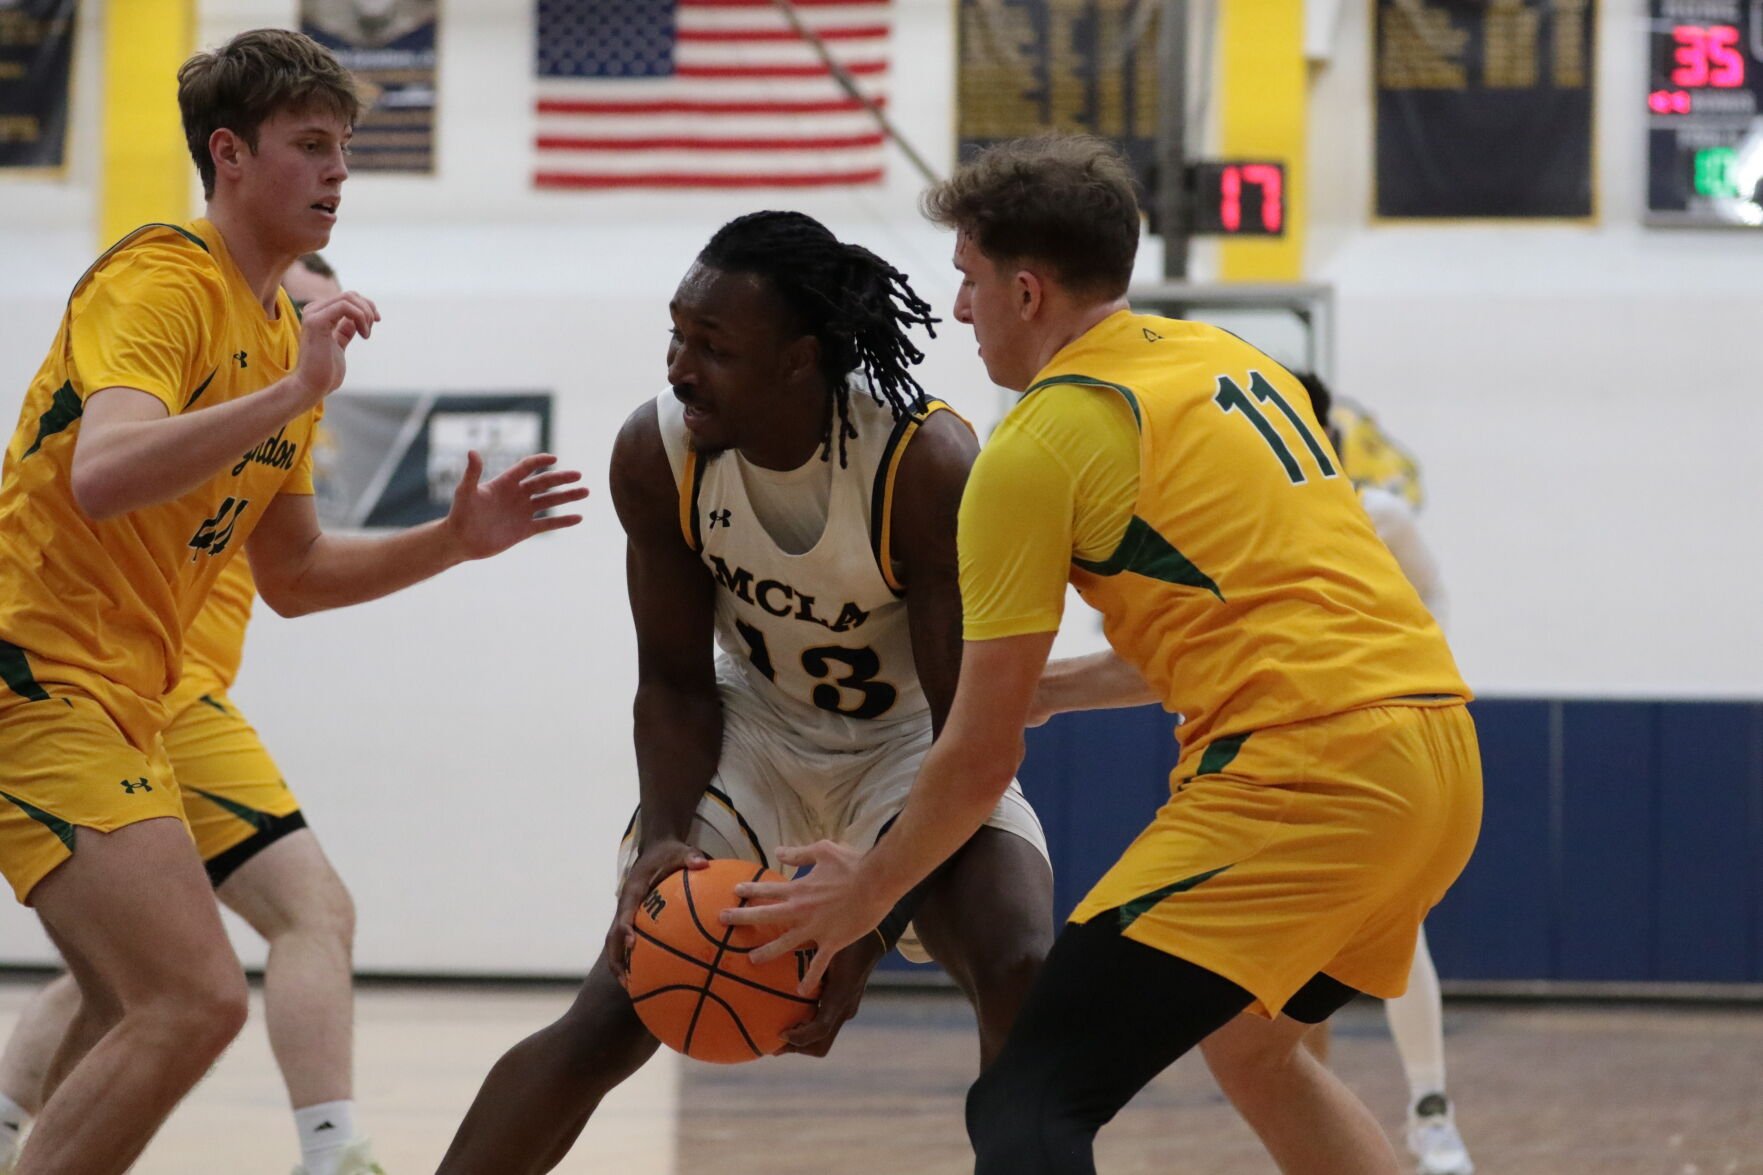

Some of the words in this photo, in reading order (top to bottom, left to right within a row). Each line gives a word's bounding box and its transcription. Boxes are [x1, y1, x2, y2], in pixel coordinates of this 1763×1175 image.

[1671, 25, 1745, 88] 35
[1221, 163, 1282, 233] 17
[231, 424, 297, 477] yndon
[1212, 370, 1340, 486] 11
[709, 554, 870, 632] MCLA
